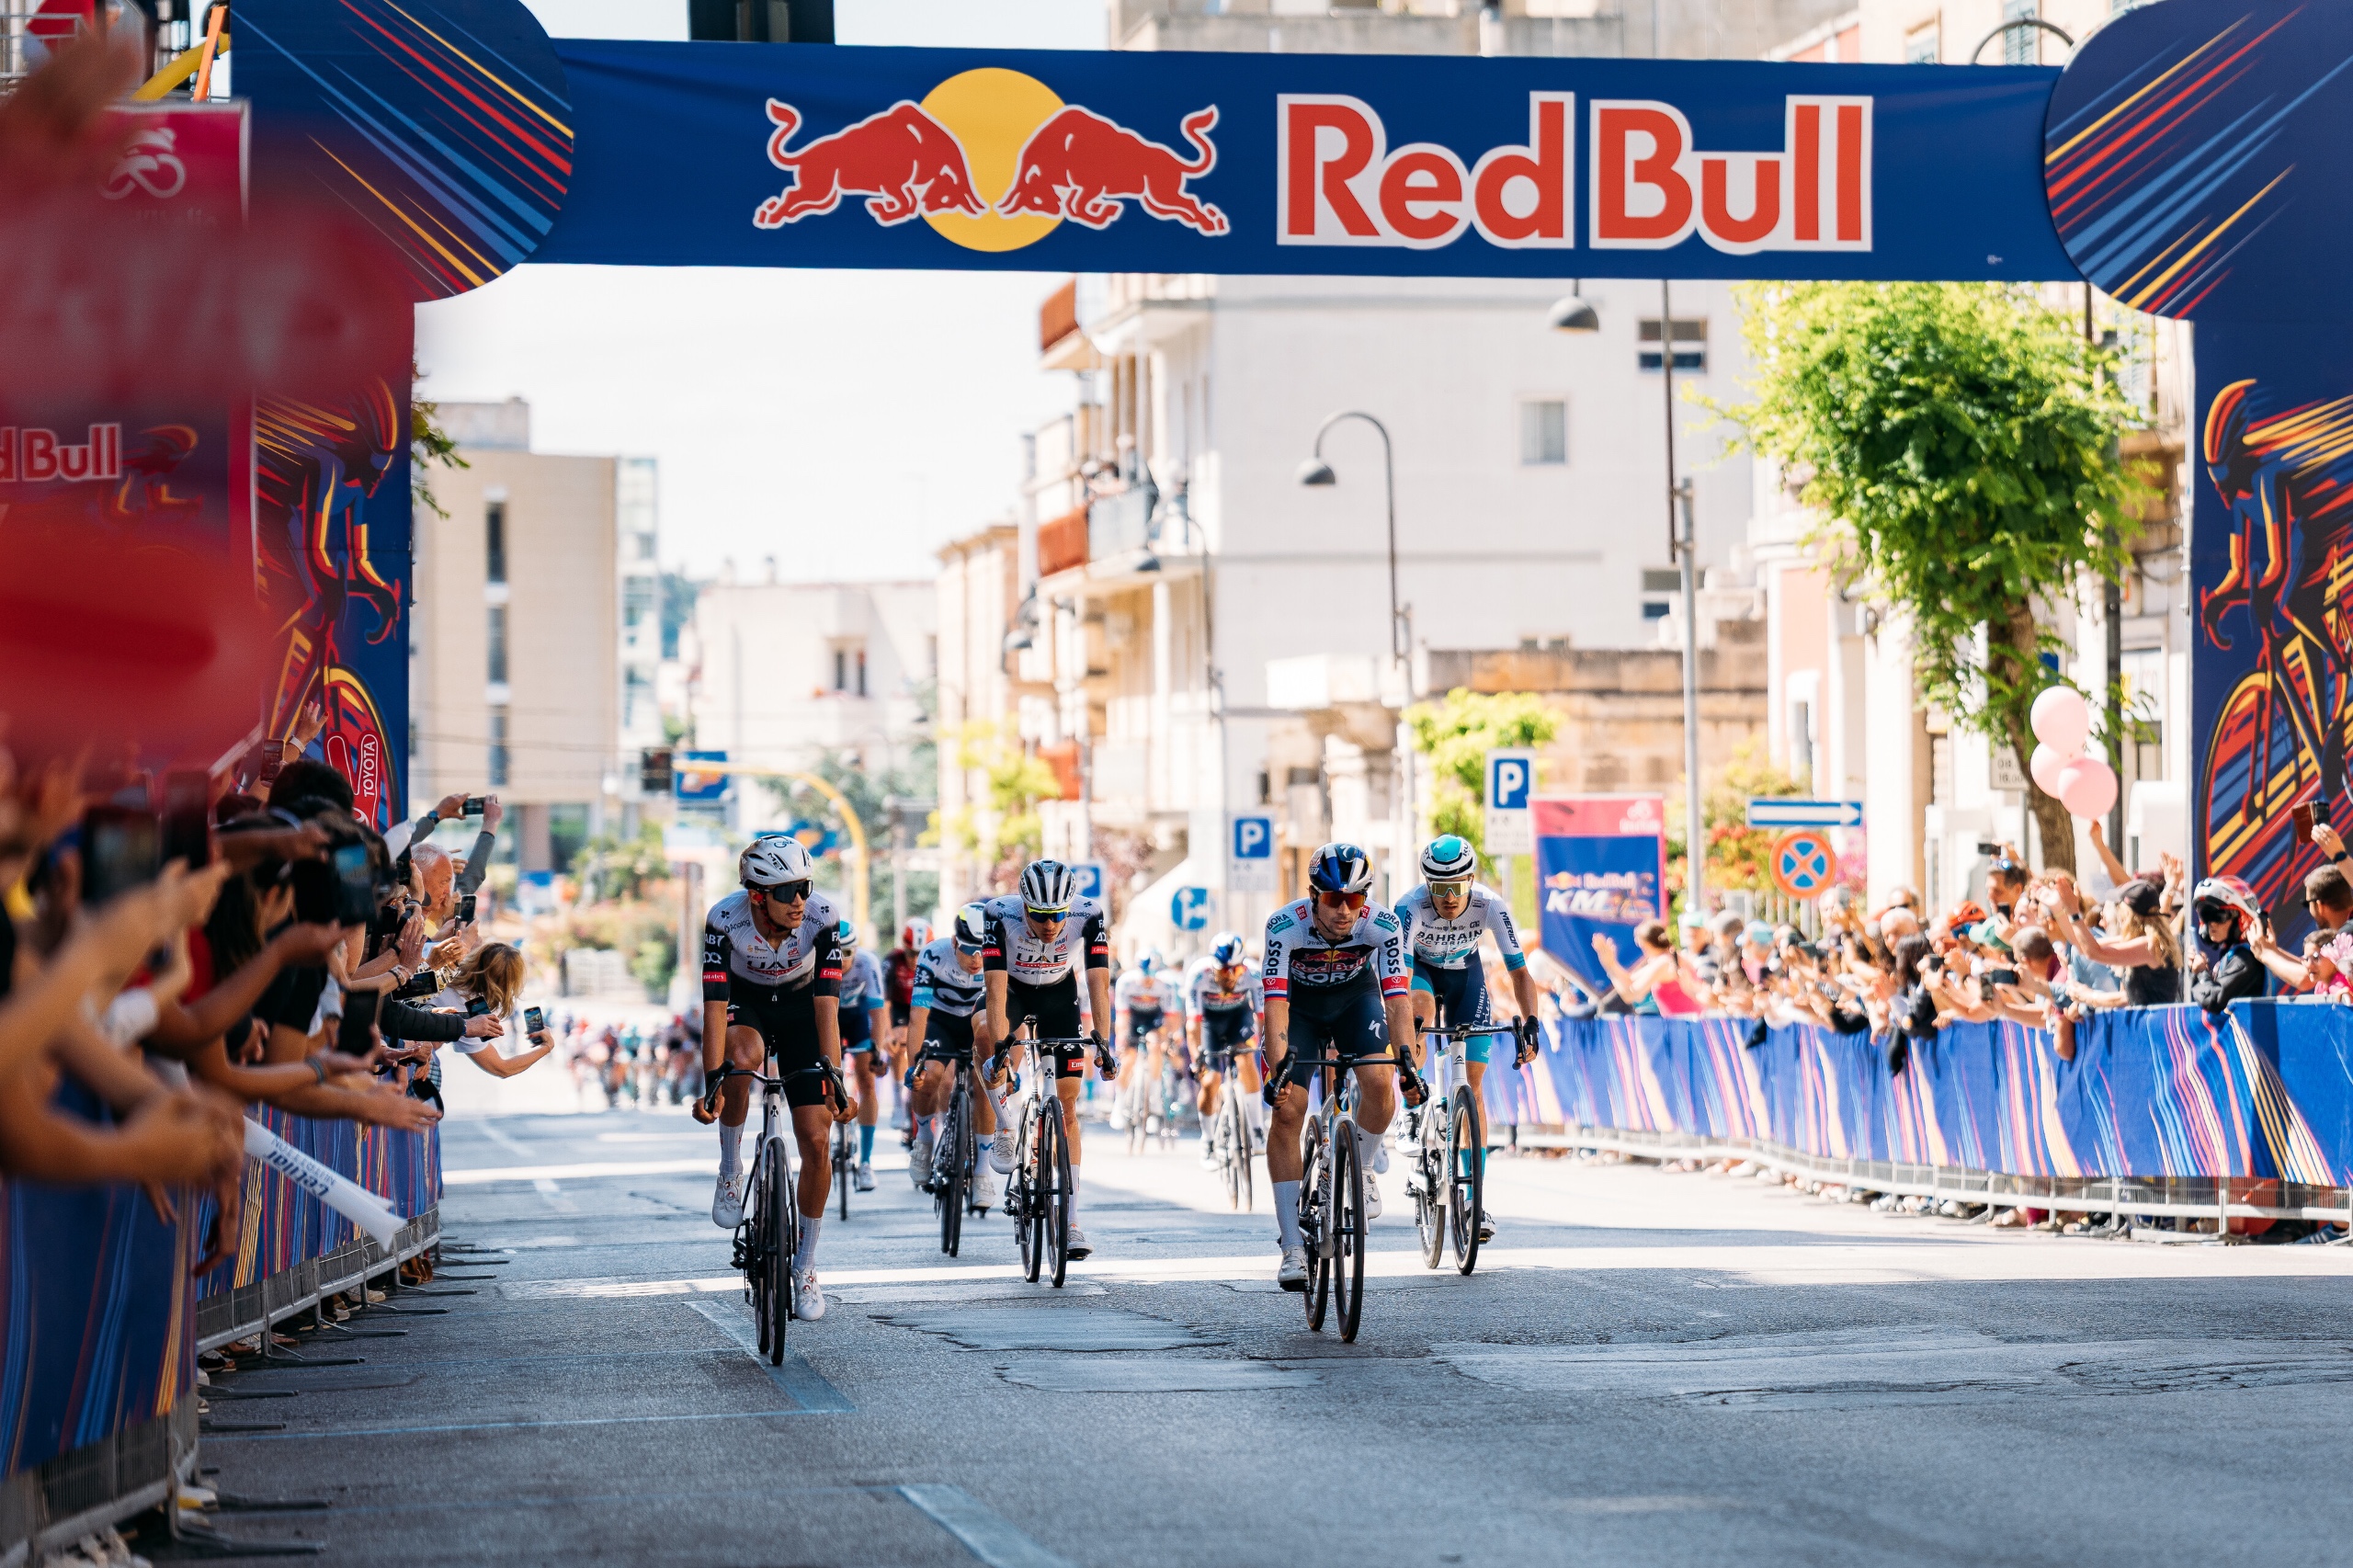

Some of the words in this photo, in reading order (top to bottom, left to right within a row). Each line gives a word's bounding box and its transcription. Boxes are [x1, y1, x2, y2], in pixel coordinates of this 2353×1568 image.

[363, 741, 376, 798] TOYOTA
[1497, 762, 1524, 805] P
[1240, 822, 1265, 855] P
[767, 852, 786, 872] MET
[1546, 890, 1609, 913] KM
[730, 919, 751, 931] Analog
[805, 915, 825, 929] Analog
[1267, 914, 1290, 930] BORA
[1378, 911, 1400, 928] BORA
[1404, 910, 1413, 949] MERIDA
[1499, 911, 1519, 949] MERIDA
[1416, 928, 1483, 942] BAHRAIN
[746, 957, 802, 971] UAE
[1016, 952, 1068, 963] UAE
[1266, 939, 1283, 976] BOSS
[1383, 936, 1401, 974] BOSS
[1290, 965, 1363, 983] BORA
[1474, 987, 1487, 1018] BUSINESS
[263, 1150, 329, 1196] Cetilar
